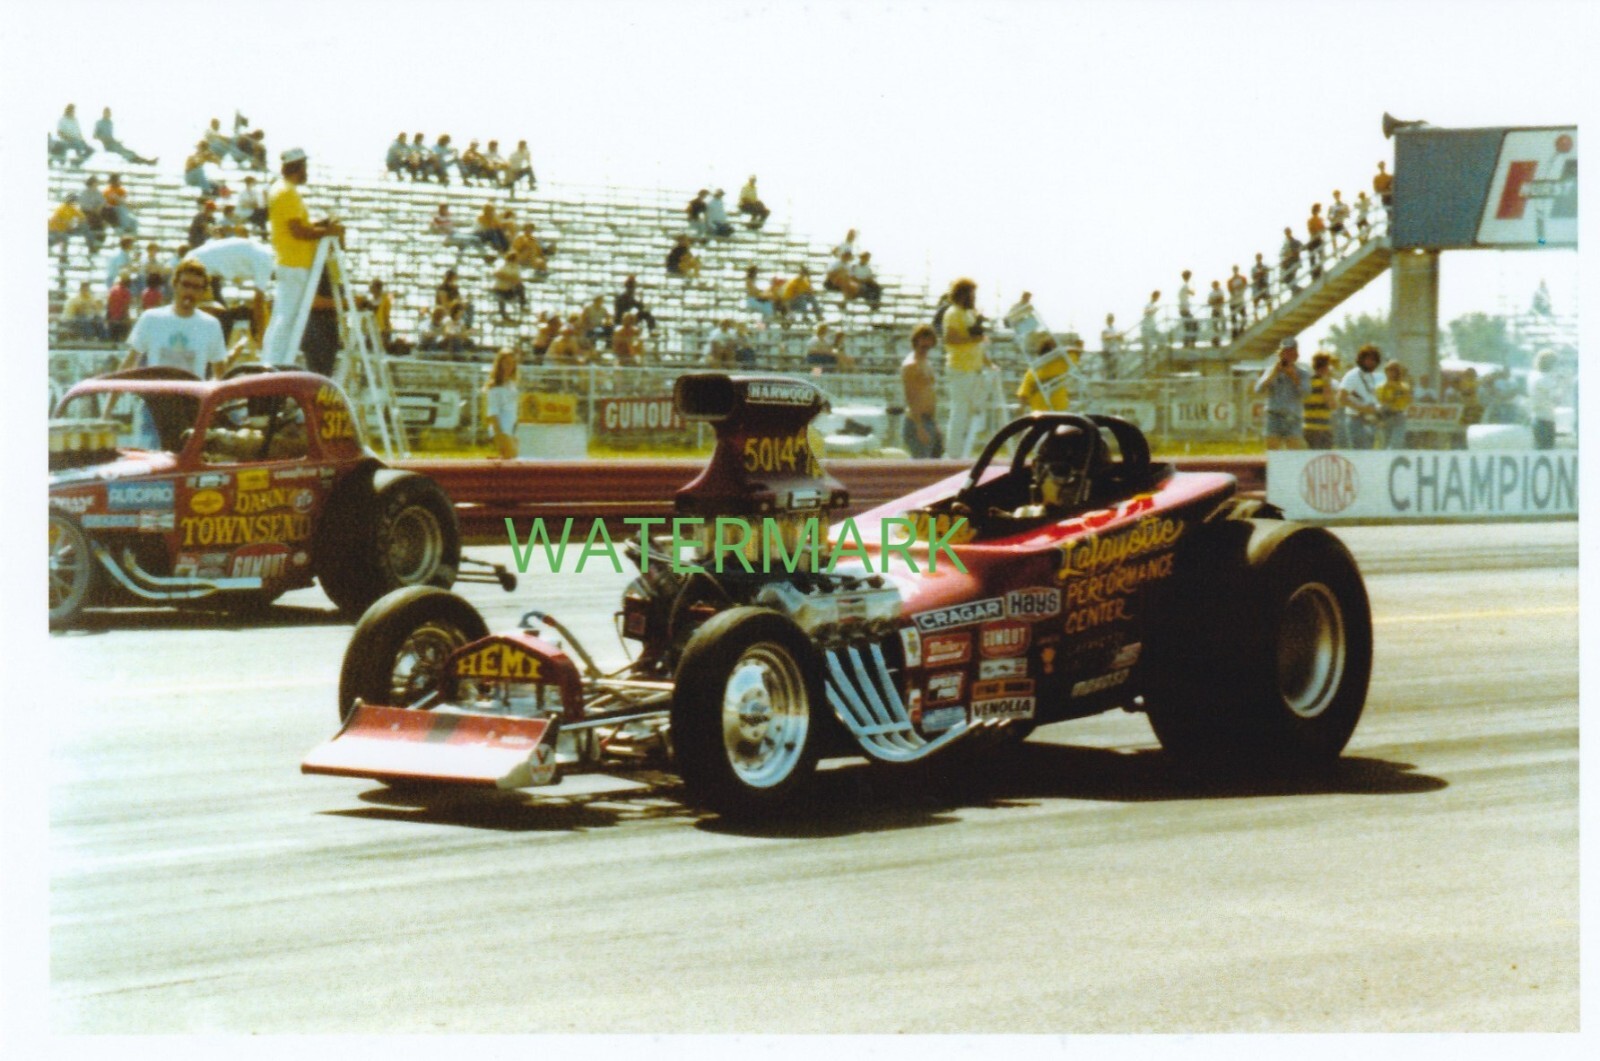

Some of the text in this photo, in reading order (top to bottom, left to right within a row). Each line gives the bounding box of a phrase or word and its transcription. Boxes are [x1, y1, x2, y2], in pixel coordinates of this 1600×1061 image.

[181, 513, 311, 546] TOWNSEND
[1066, 552, 1174, 608] PERFORMANCE
[919, 602, 1000, 628] CRAGAR
[1011, 590, 1058, 614] Hays
[1064, 597, 1133, 634] CENTER
[457, 643, 543, 679] HEMI
[973, 699, 1032, 718] VENOLIA
